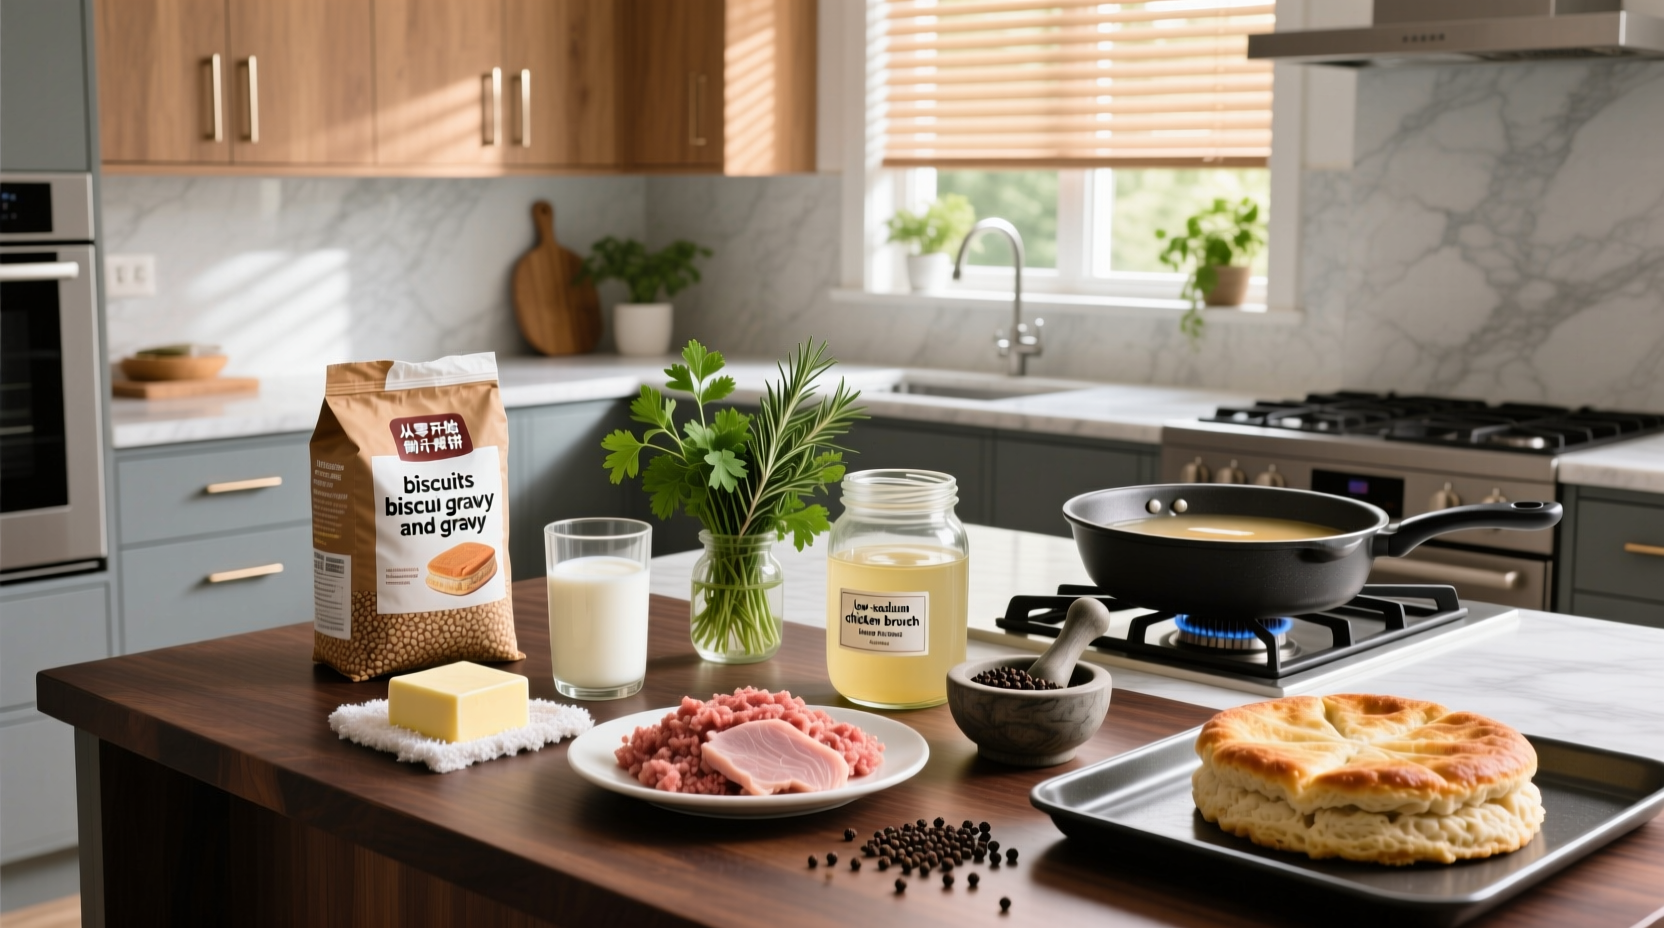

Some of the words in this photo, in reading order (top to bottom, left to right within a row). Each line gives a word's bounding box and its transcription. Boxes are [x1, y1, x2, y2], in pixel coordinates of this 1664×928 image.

[403, 472, 475, 494] biscuits
[445, 493, 495, 517] gravy
[400, 516, 436, 536] and
[440, 515, 487, 538] gravy
